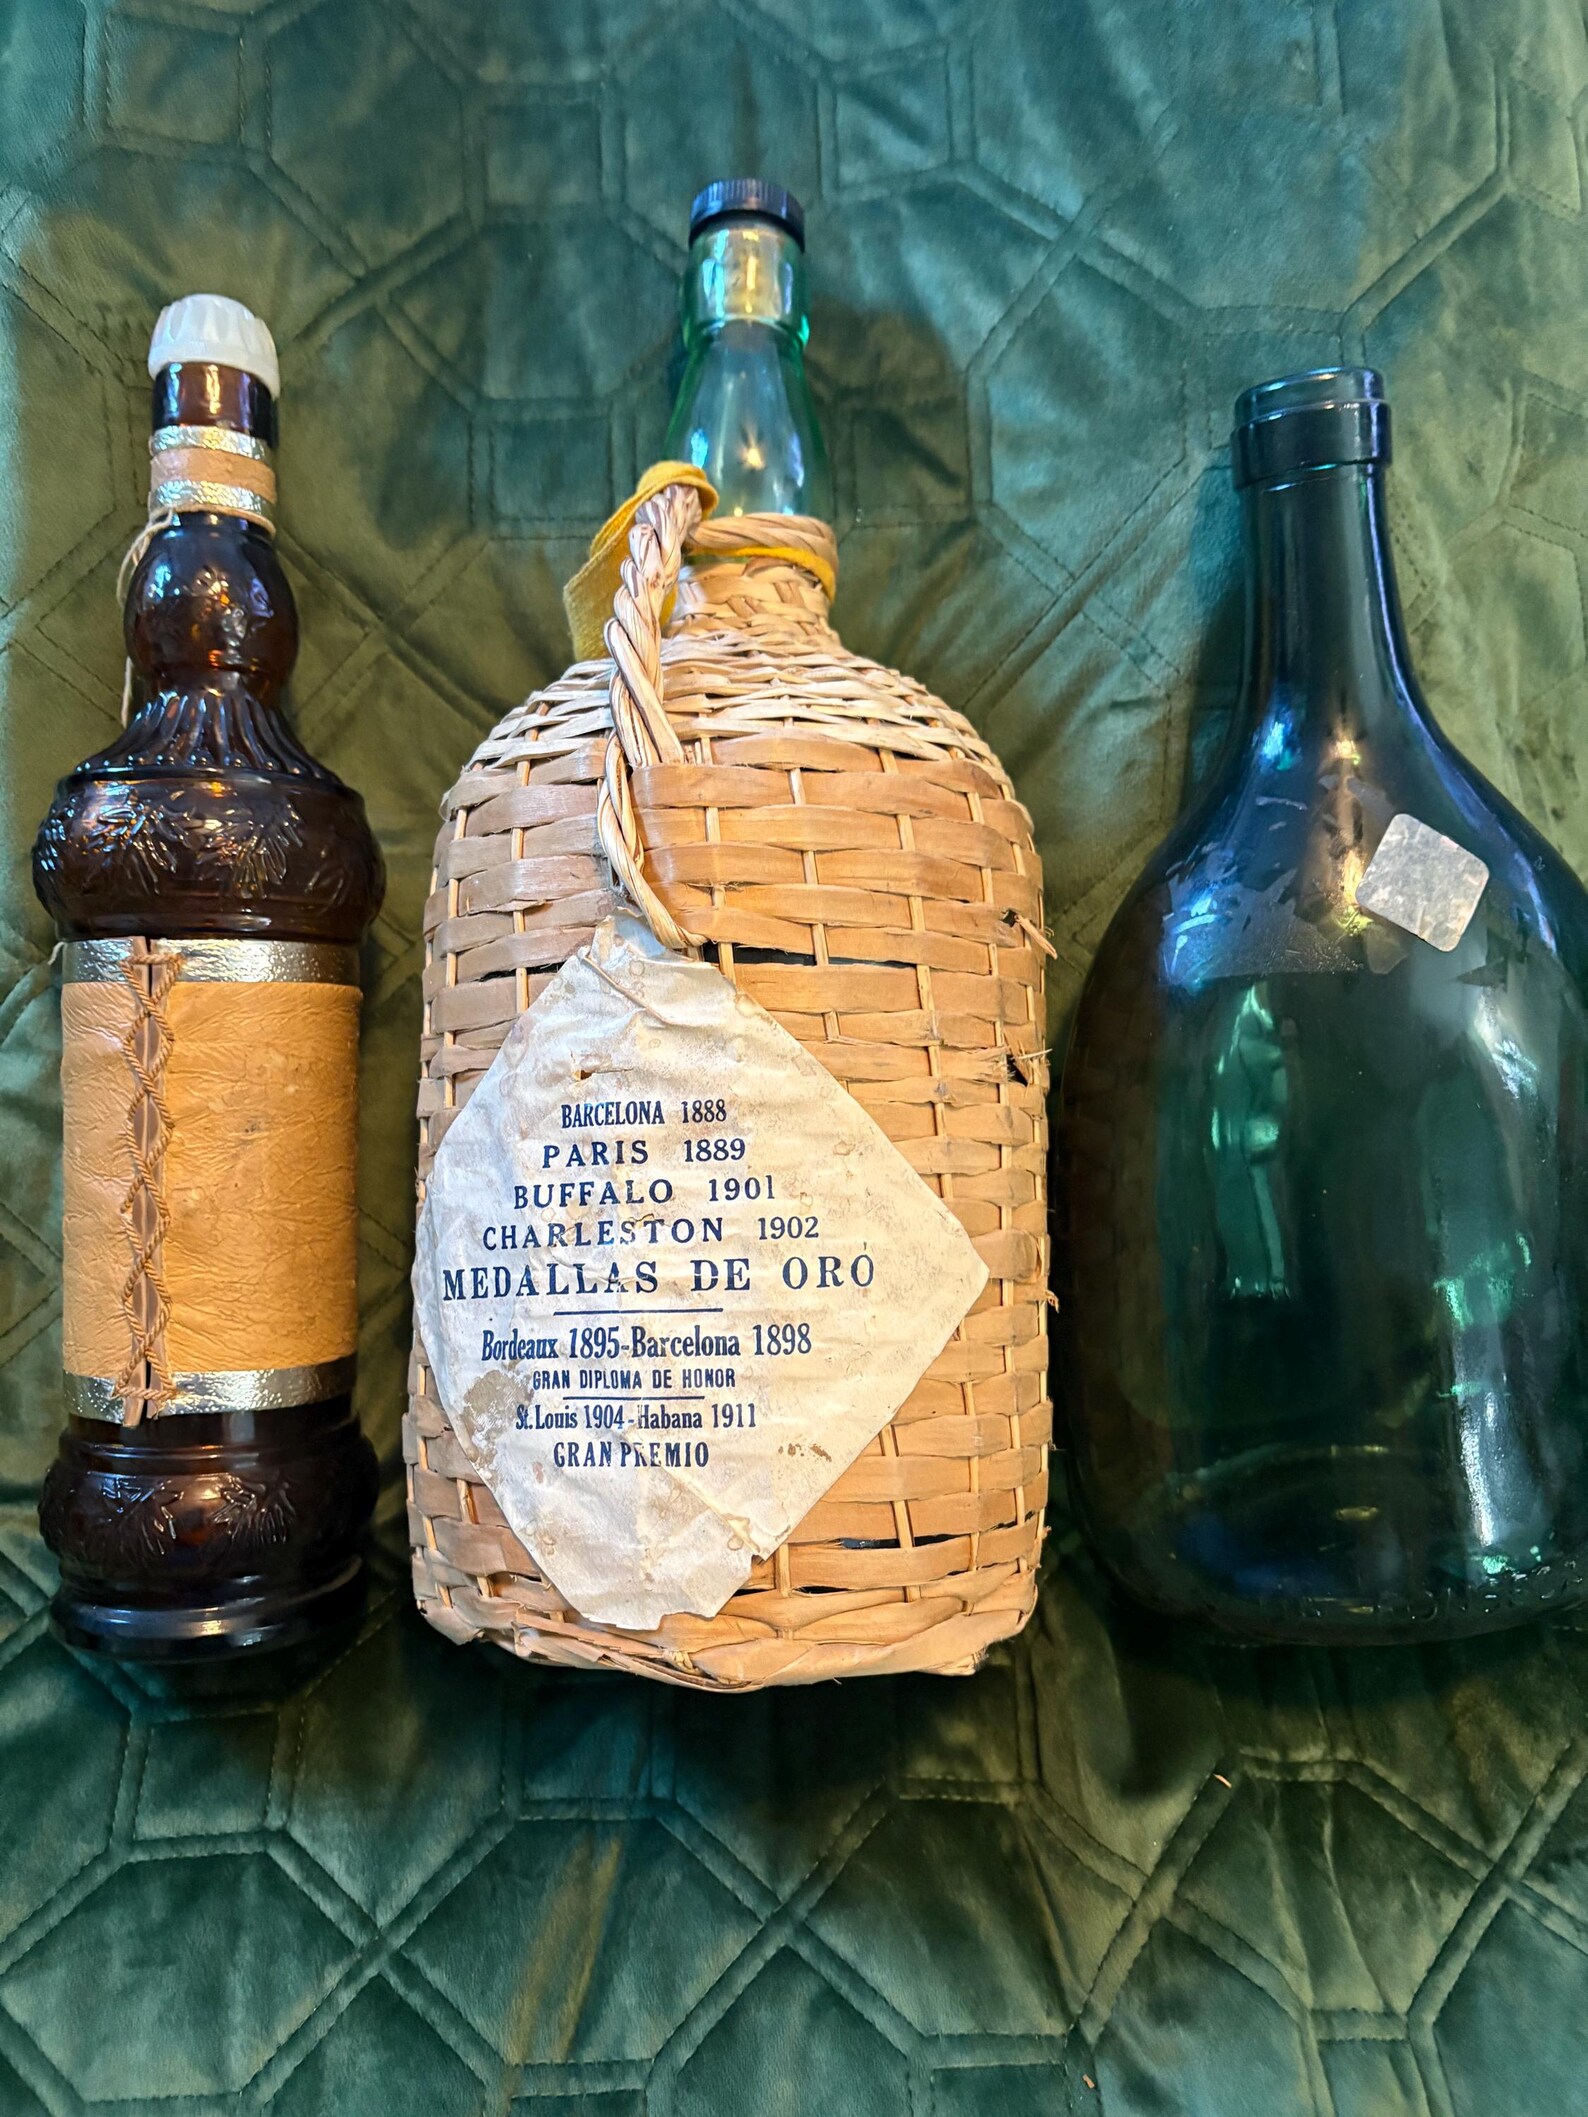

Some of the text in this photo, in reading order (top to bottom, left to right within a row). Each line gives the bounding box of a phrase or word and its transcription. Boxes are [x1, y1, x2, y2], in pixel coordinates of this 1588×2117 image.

[561, 1099, 727, 1129] BARCELONA 1888
[543, 1138, 745, 1168] PARIS 1889
[514, 1175, 774, 1209] BUFFALO 1901
[483, 1216, 819, 1250] CHARLESTON 1902
[443, 1254, 874, 1301] MEDALLAS DE ORO
[482, 1329, 558, 1361] Bordeaux
[753, 1323, 812, 1356] 1898
[533, 1368, 735, 1389] GRAN DIPLOMA DE HONOR
[712, 1403, 756, 1428] 1911
[554, 1442, 708, 1468] GRAN PREMIO
